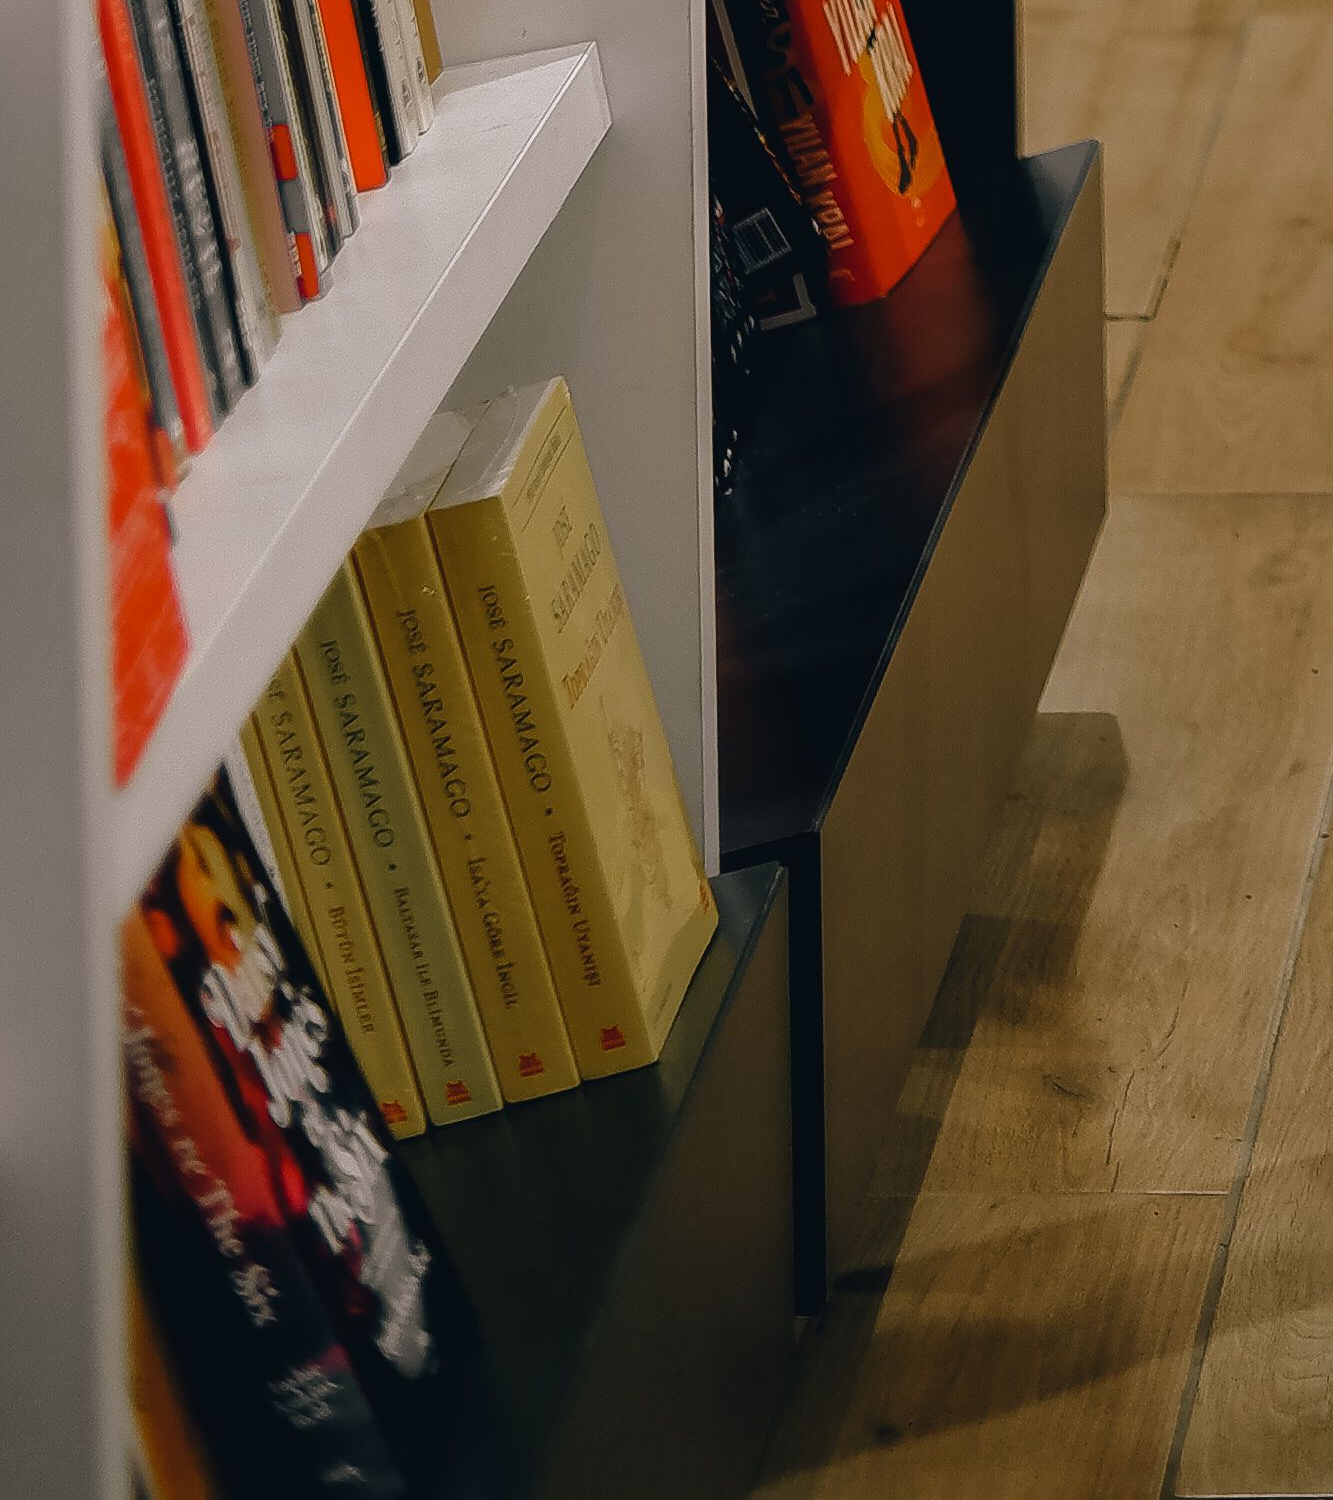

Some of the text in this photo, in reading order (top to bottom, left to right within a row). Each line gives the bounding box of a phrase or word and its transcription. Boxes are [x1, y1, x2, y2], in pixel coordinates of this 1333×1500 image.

[317, 638, 349, 688] JOSÉ
[395, 606, 429, 657] JOSÉ
[477, 582, 507, 633] JOSÉ
[270, 708, 333, 869] SARAMAGO
[330, 691, 398, 852] SARAMAGO
[409, 660, 474, 822] SARAMAGO
[490, 635, 553, 796] SARAMAGO
